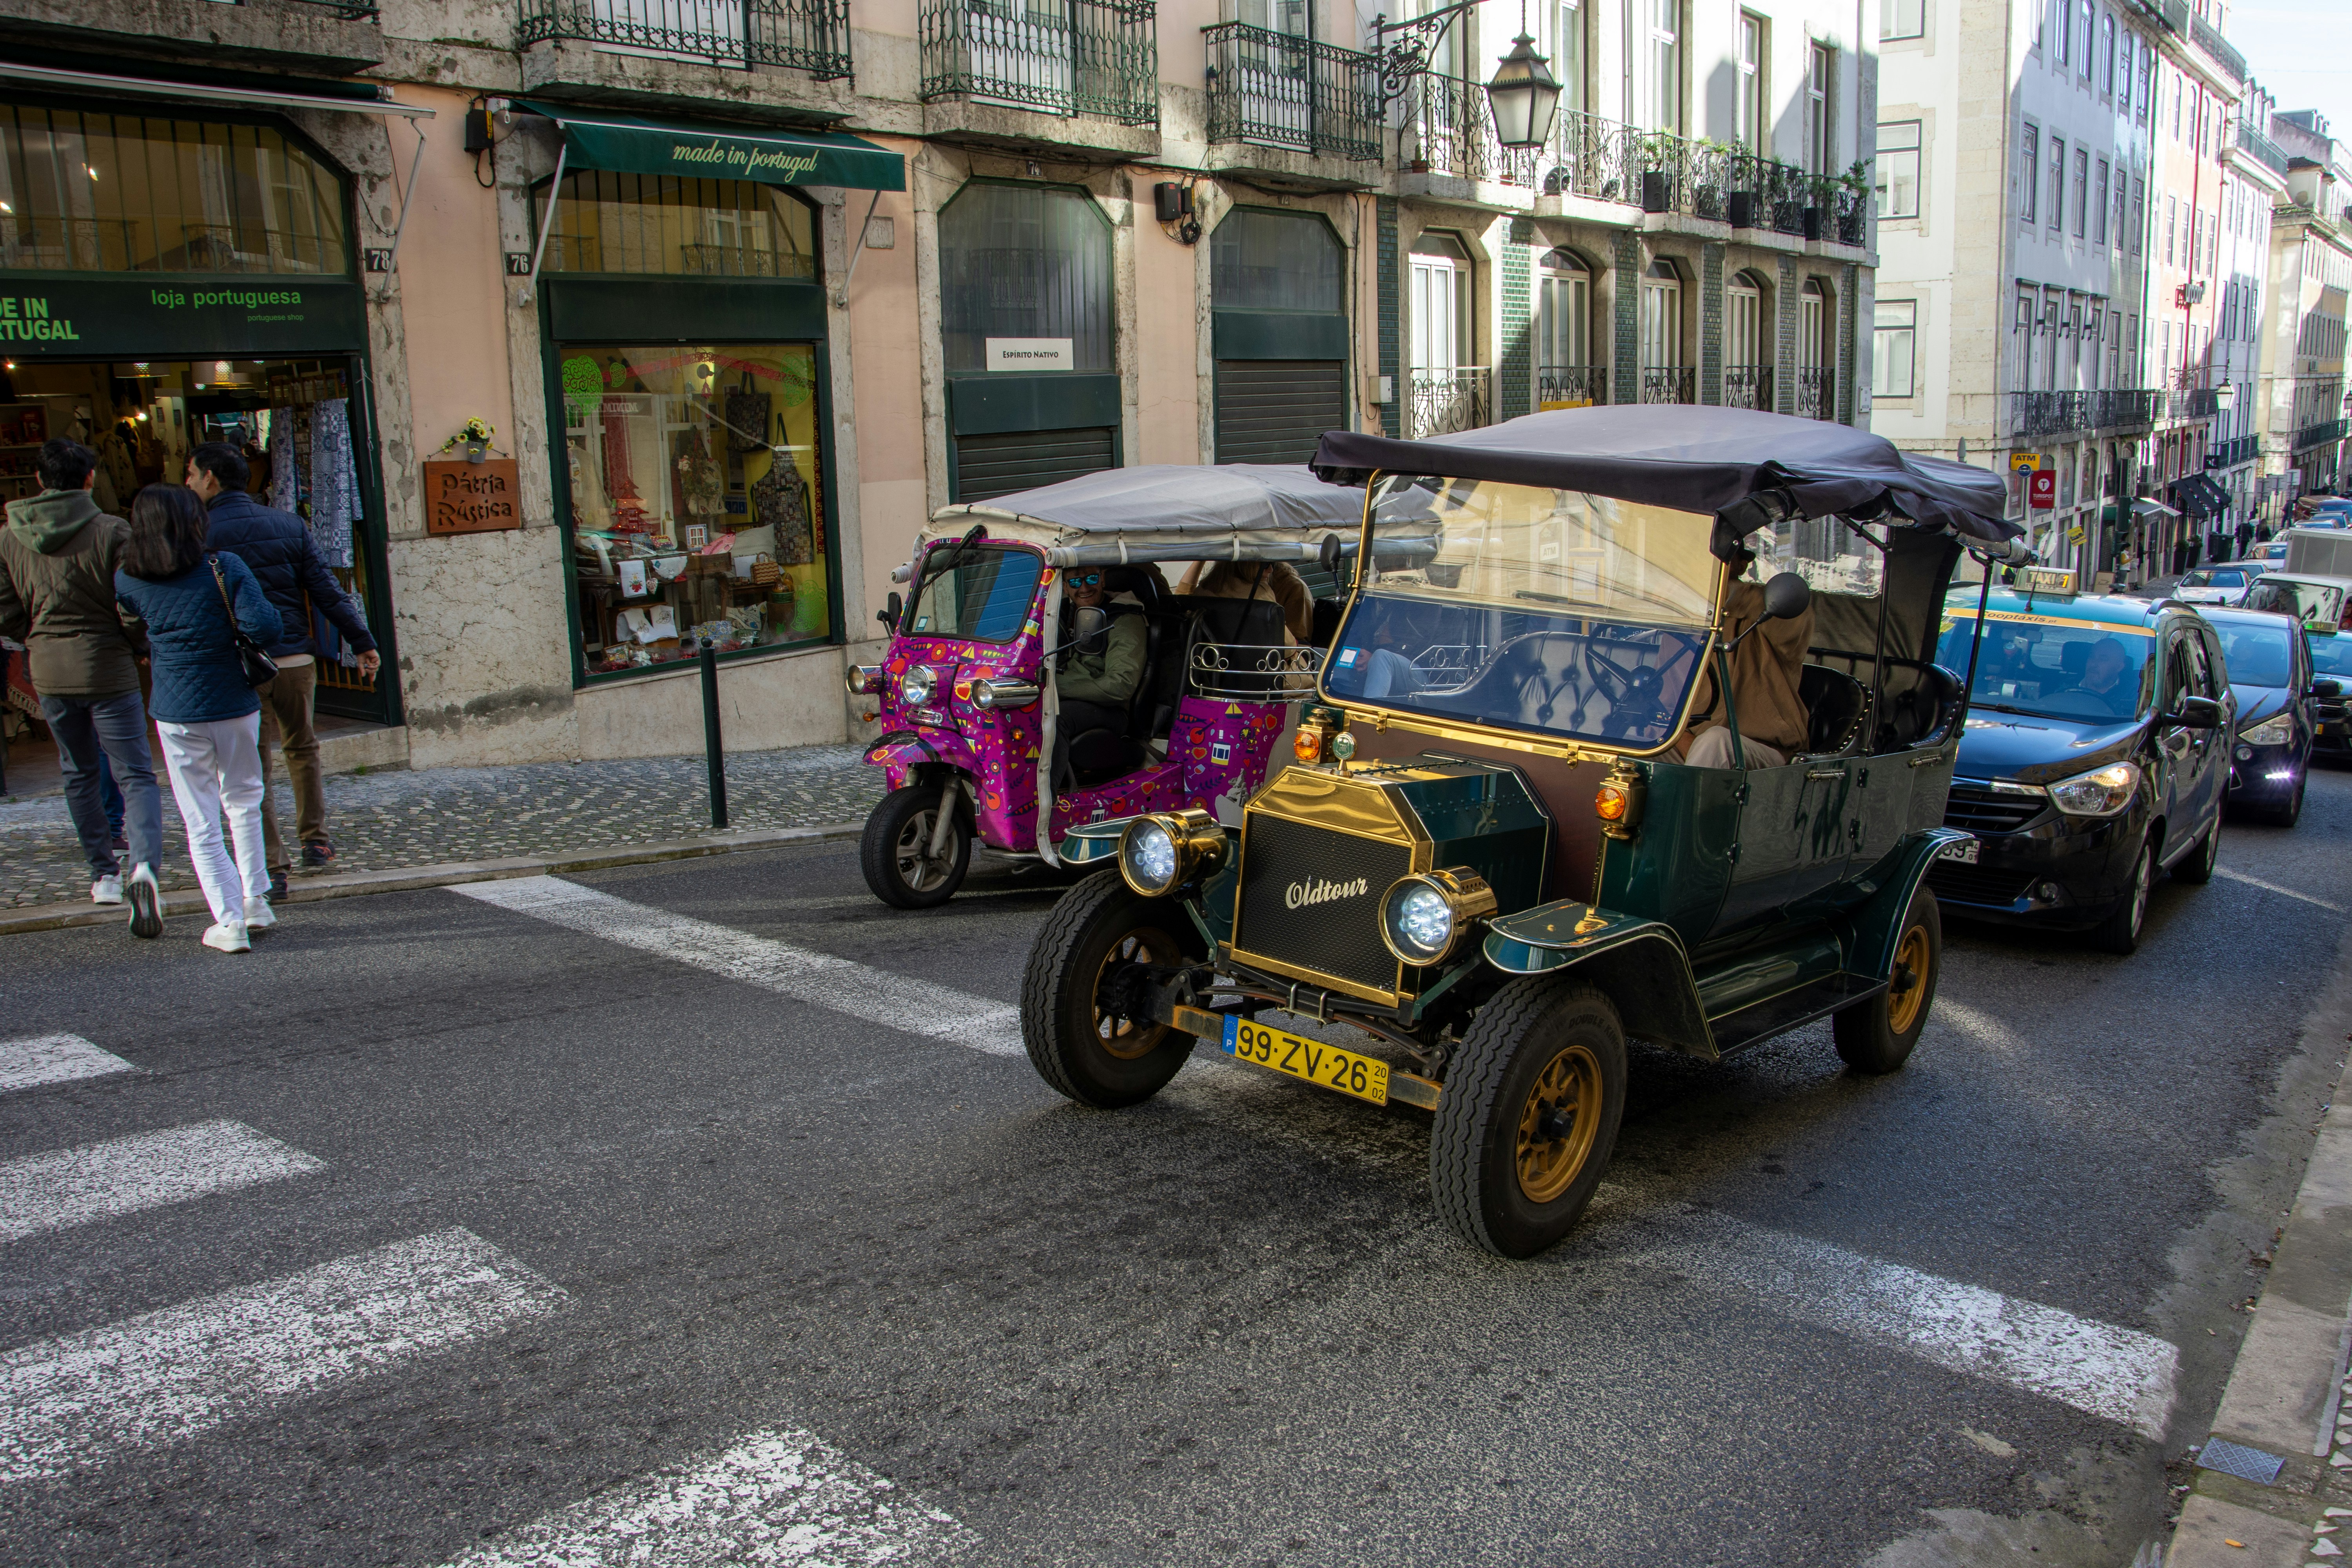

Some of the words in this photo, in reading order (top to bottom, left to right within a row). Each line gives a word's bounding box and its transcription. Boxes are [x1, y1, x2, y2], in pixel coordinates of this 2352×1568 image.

[673, 140, 724, 163] made
[728, 146, 748, 164] in
[745, 148, 819, 183] portugal
[1029, 161, 1040, 175] 74
[371, 250, 390, 270] 78
[511, 255, 528, 273] 76
[0, 298, 19, 318] E
[24, 298, 49, 318] IN
[152, 290, 185, 309] loja
[194, 289, 302, 309] portuguesa
[1003, 350, 1032, 358] ESPÍRITO
[441, 472, 506, 499] Pátria
[437, 499, 513, 527] Rústica
[1543, 546, 1556, 557] ATM
[2029, 571, 2056, 584] TAXI
[2062, 575, 2069, 588] 1
[1285, 877, 1368, 909] Oldtour
[1226, 1039, 1232, 1047] P
[1374, 1065, 1387, 1078] 20
[1372, 1087, 1384, 1101] 02
